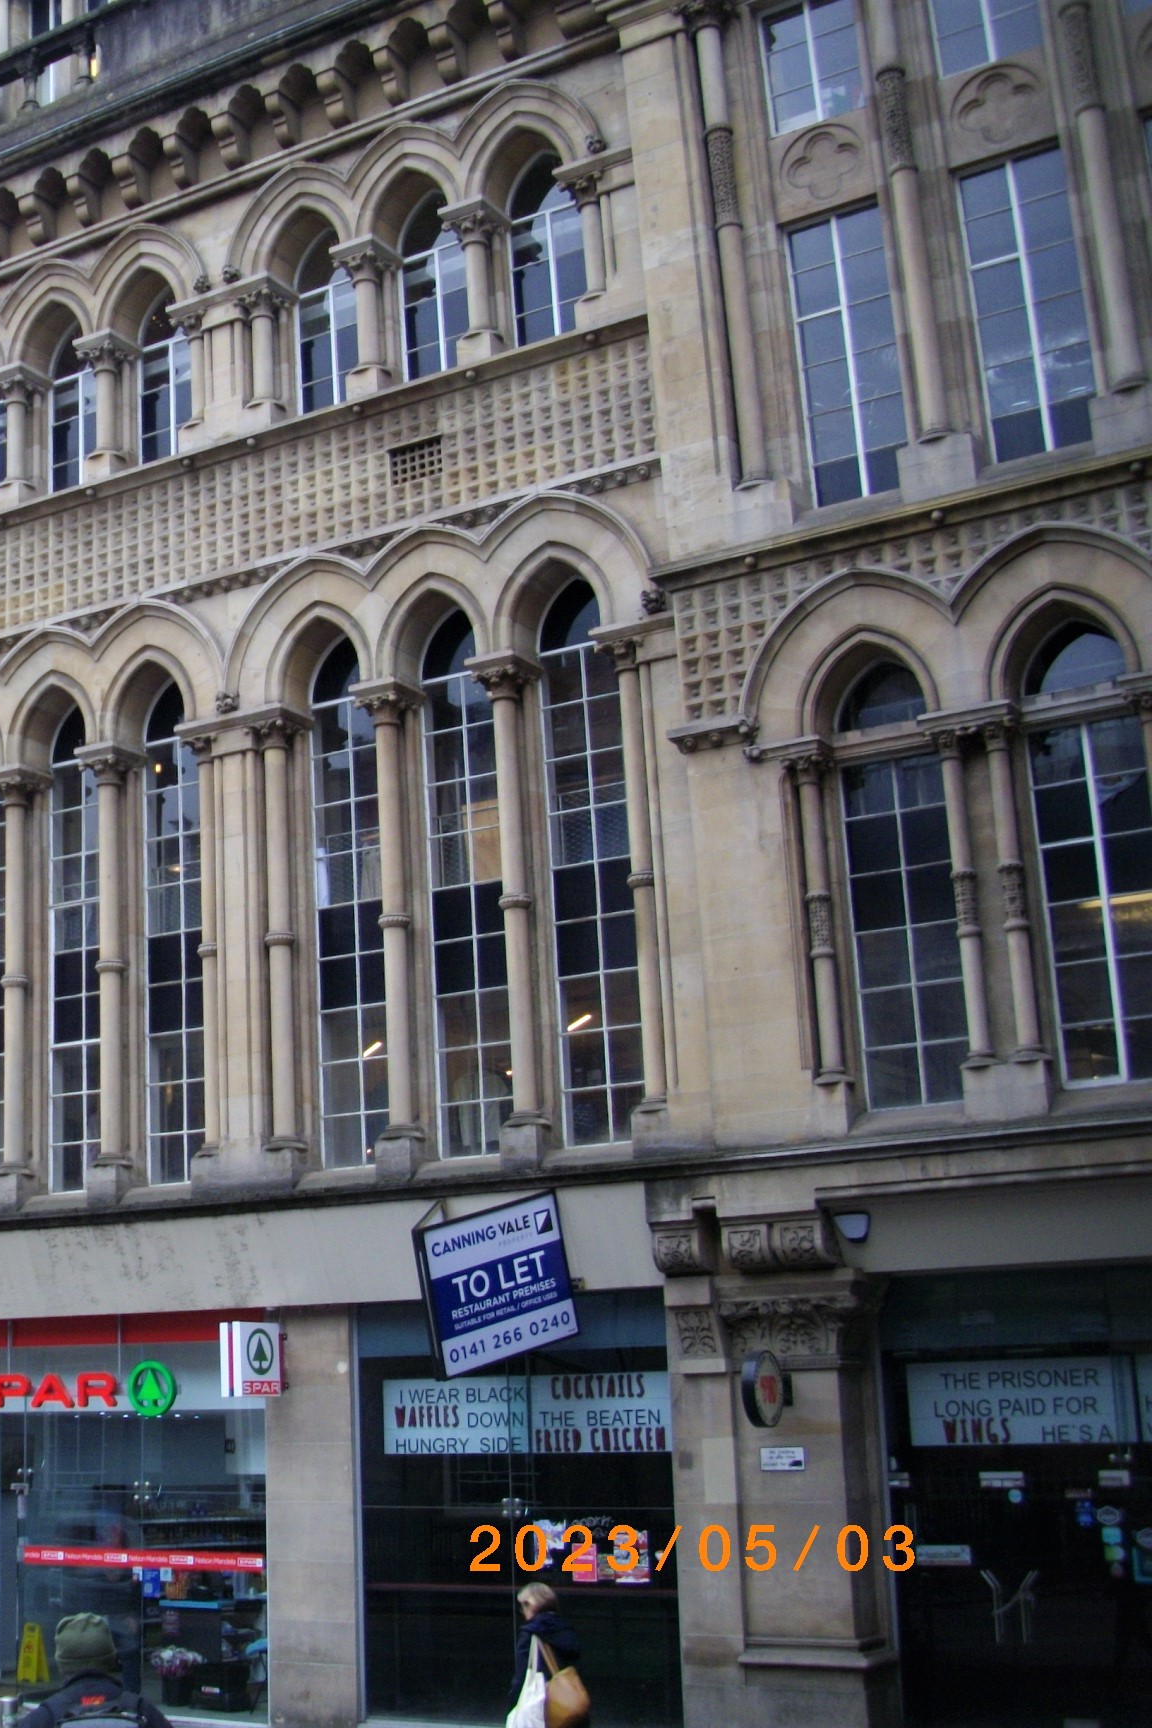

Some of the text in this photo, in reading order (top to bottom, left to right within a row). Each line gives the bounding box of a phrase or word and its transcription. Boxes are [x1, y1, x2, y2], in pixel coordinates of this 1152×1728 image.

[431, 1215, 531, 1257] CANNING VALE
[451, 1250, 546, 1304] TO LET
[451, 1278, 557, 1320] RESTAURANT PREMISES
[454, 1316, 482, 1331] SUITABLE
[482, 1311, 495, 1322] FOR
[496, 1305, 516, 1318] RETAIL
[521, 1298, 542, 1309] OFFICE
[542, 1291, 558, 1303] USES
[449, 1311, 570, 1363] 0141 266 0240
[243, 1382, 280, 1394] SPAR
[550, 1373, 645, 1400] COCKTAILS
[939, 1368, 1100, 1390] THE PRISONER
[399, 1386, 526, 1405] I WEAR BLACK
[933, 1396, 1099, 1418] LONG PAID FOR
[394, 1405, 524, 1428] WAFFLES DOWN
[539, 1409, 661, 1427] THE BEATEN
[535, 1426, 666, 1452] FRIED CHICKEN
[943, 1417, 1011, 1443] WINGS
[1098, 1424, 1114, 1442] A
[395, 1437, 523, 1453] HUNGRY SIDE
